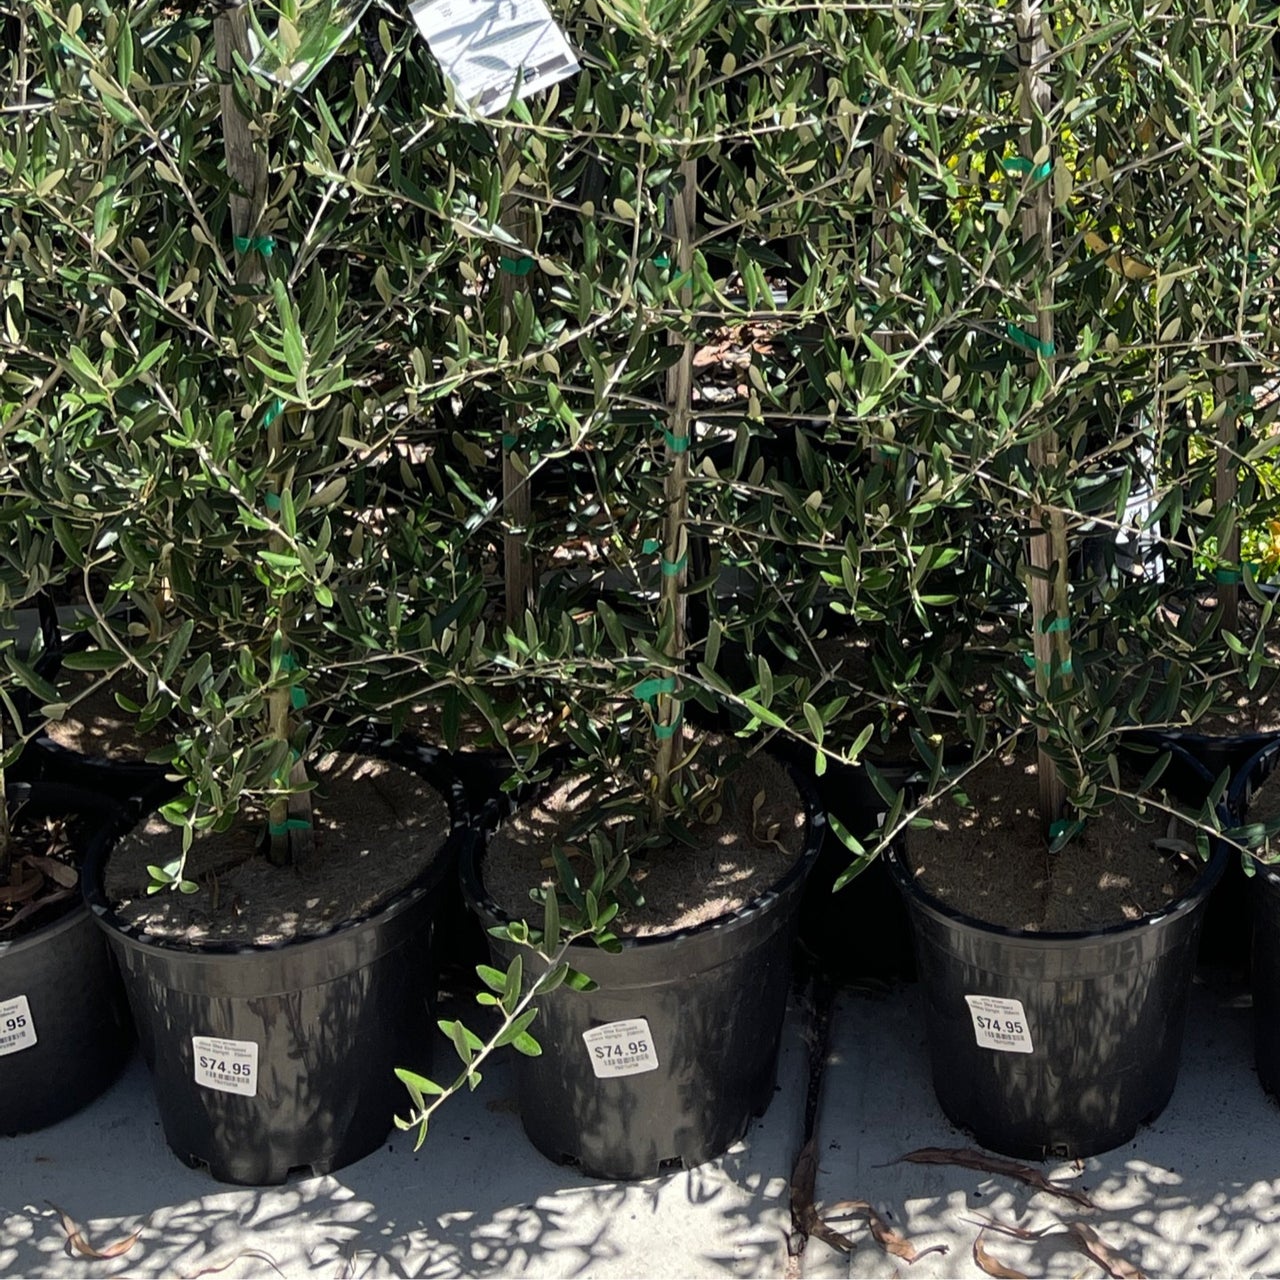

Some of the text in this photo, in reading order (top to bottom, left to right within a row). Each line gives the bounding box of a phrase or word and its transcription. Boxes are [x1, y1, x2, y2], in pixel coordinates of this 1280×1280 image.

[976, 1015, 1024, 1034] $74.95
[594, 1039, 648, 1059] $74.95
[199, 1055, 252, 1076] $74.95
